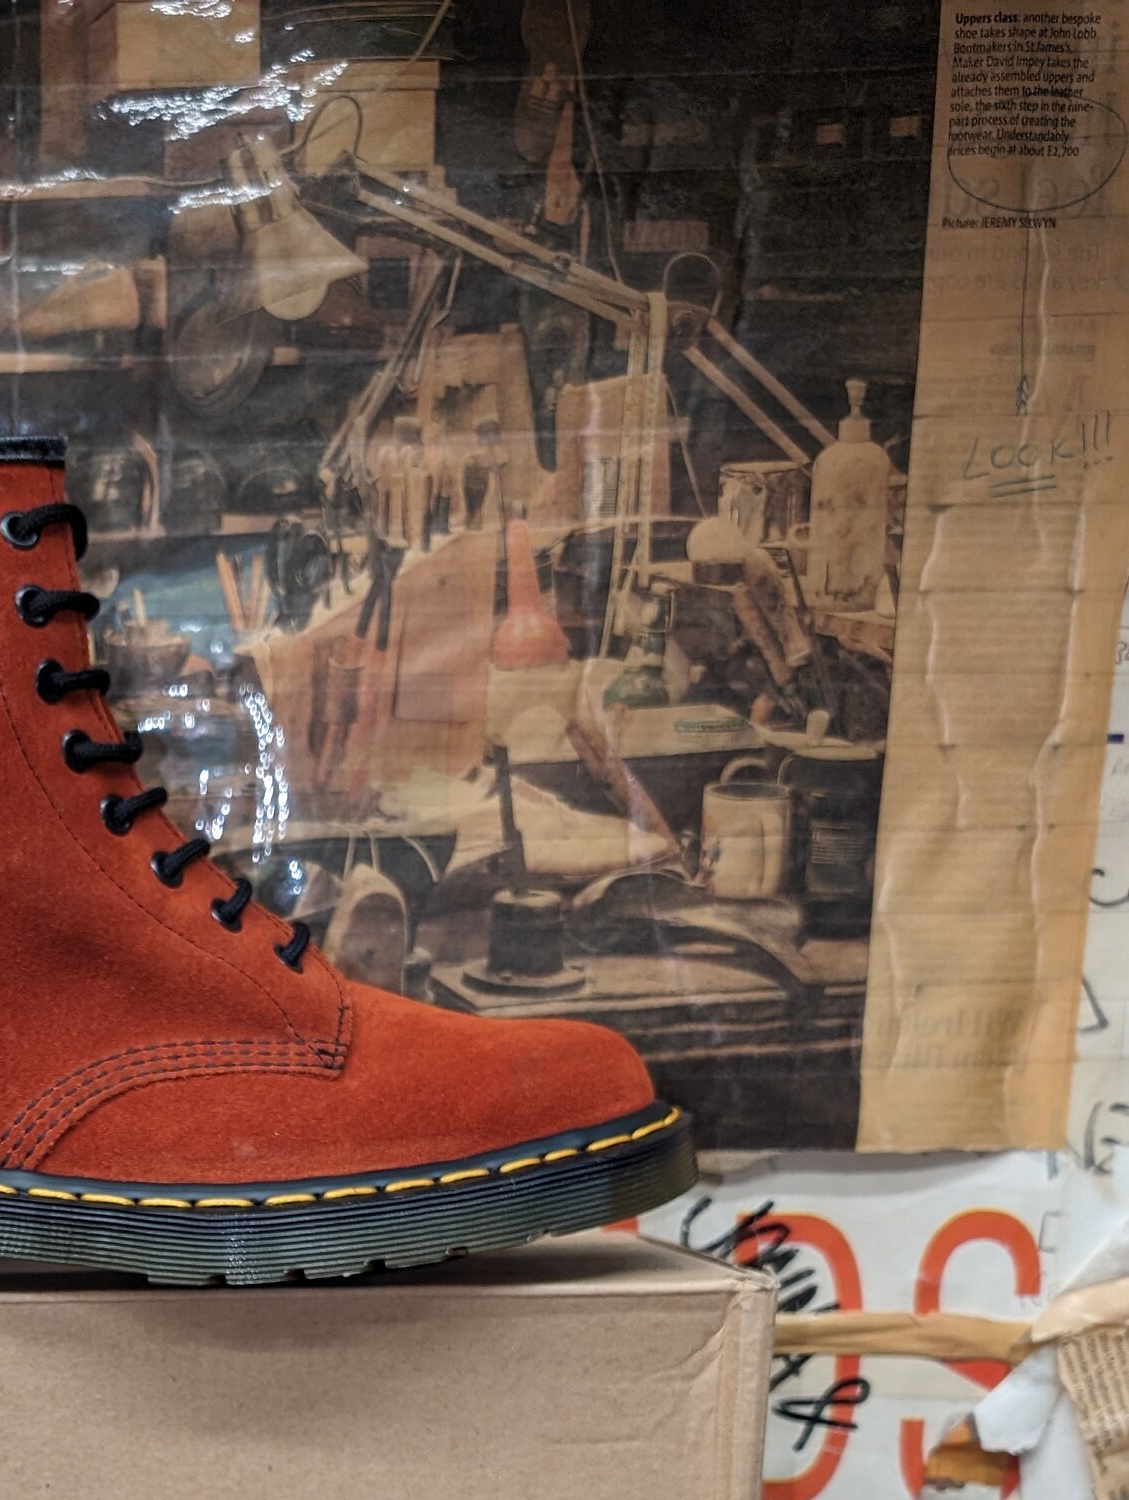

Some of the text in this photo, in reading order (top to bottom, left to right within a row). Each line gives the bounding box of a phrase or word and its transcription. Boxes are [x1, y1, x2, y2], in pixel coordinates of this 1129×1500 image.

[955, 12, 991, 26] Uppers
[1023, 12, 1059, 24] another
[1061, 12, 1101, 27] bespoke
[954, 26, 1097, 40] shoe takes shape at John Lobb
[953, 42, 1011, 54] Bootmakers
[1014, 41, 1023, 52] in
[1025, 41, 1034, 52] St
[952, 55, 1089, 70] Maker David Impey takes the
[951, 69, 1095, 85] already assembled uppers and
[951, 85, 1084, 98] attaches them to the leather
[975, 100, 992, 112] the
[994, 99, 1017, 111] sixth
[1019, 101, 1039, 114] step
[1041, 100, 1050, 112] in
[1052, 101, 1066, 112] the
[949, 113, 1076, 130] part process of creating the
[996, 128, 1070, 144] Understandably
[978, 144, 1006, 158] begin
[1007, 145, 1017, 155] at
[1019, 144, 1045, 156] about
[1047, 145, 1080, 158] £2,700
[942, 216, 1057, 229] Picture: JEREMY SELWYN
